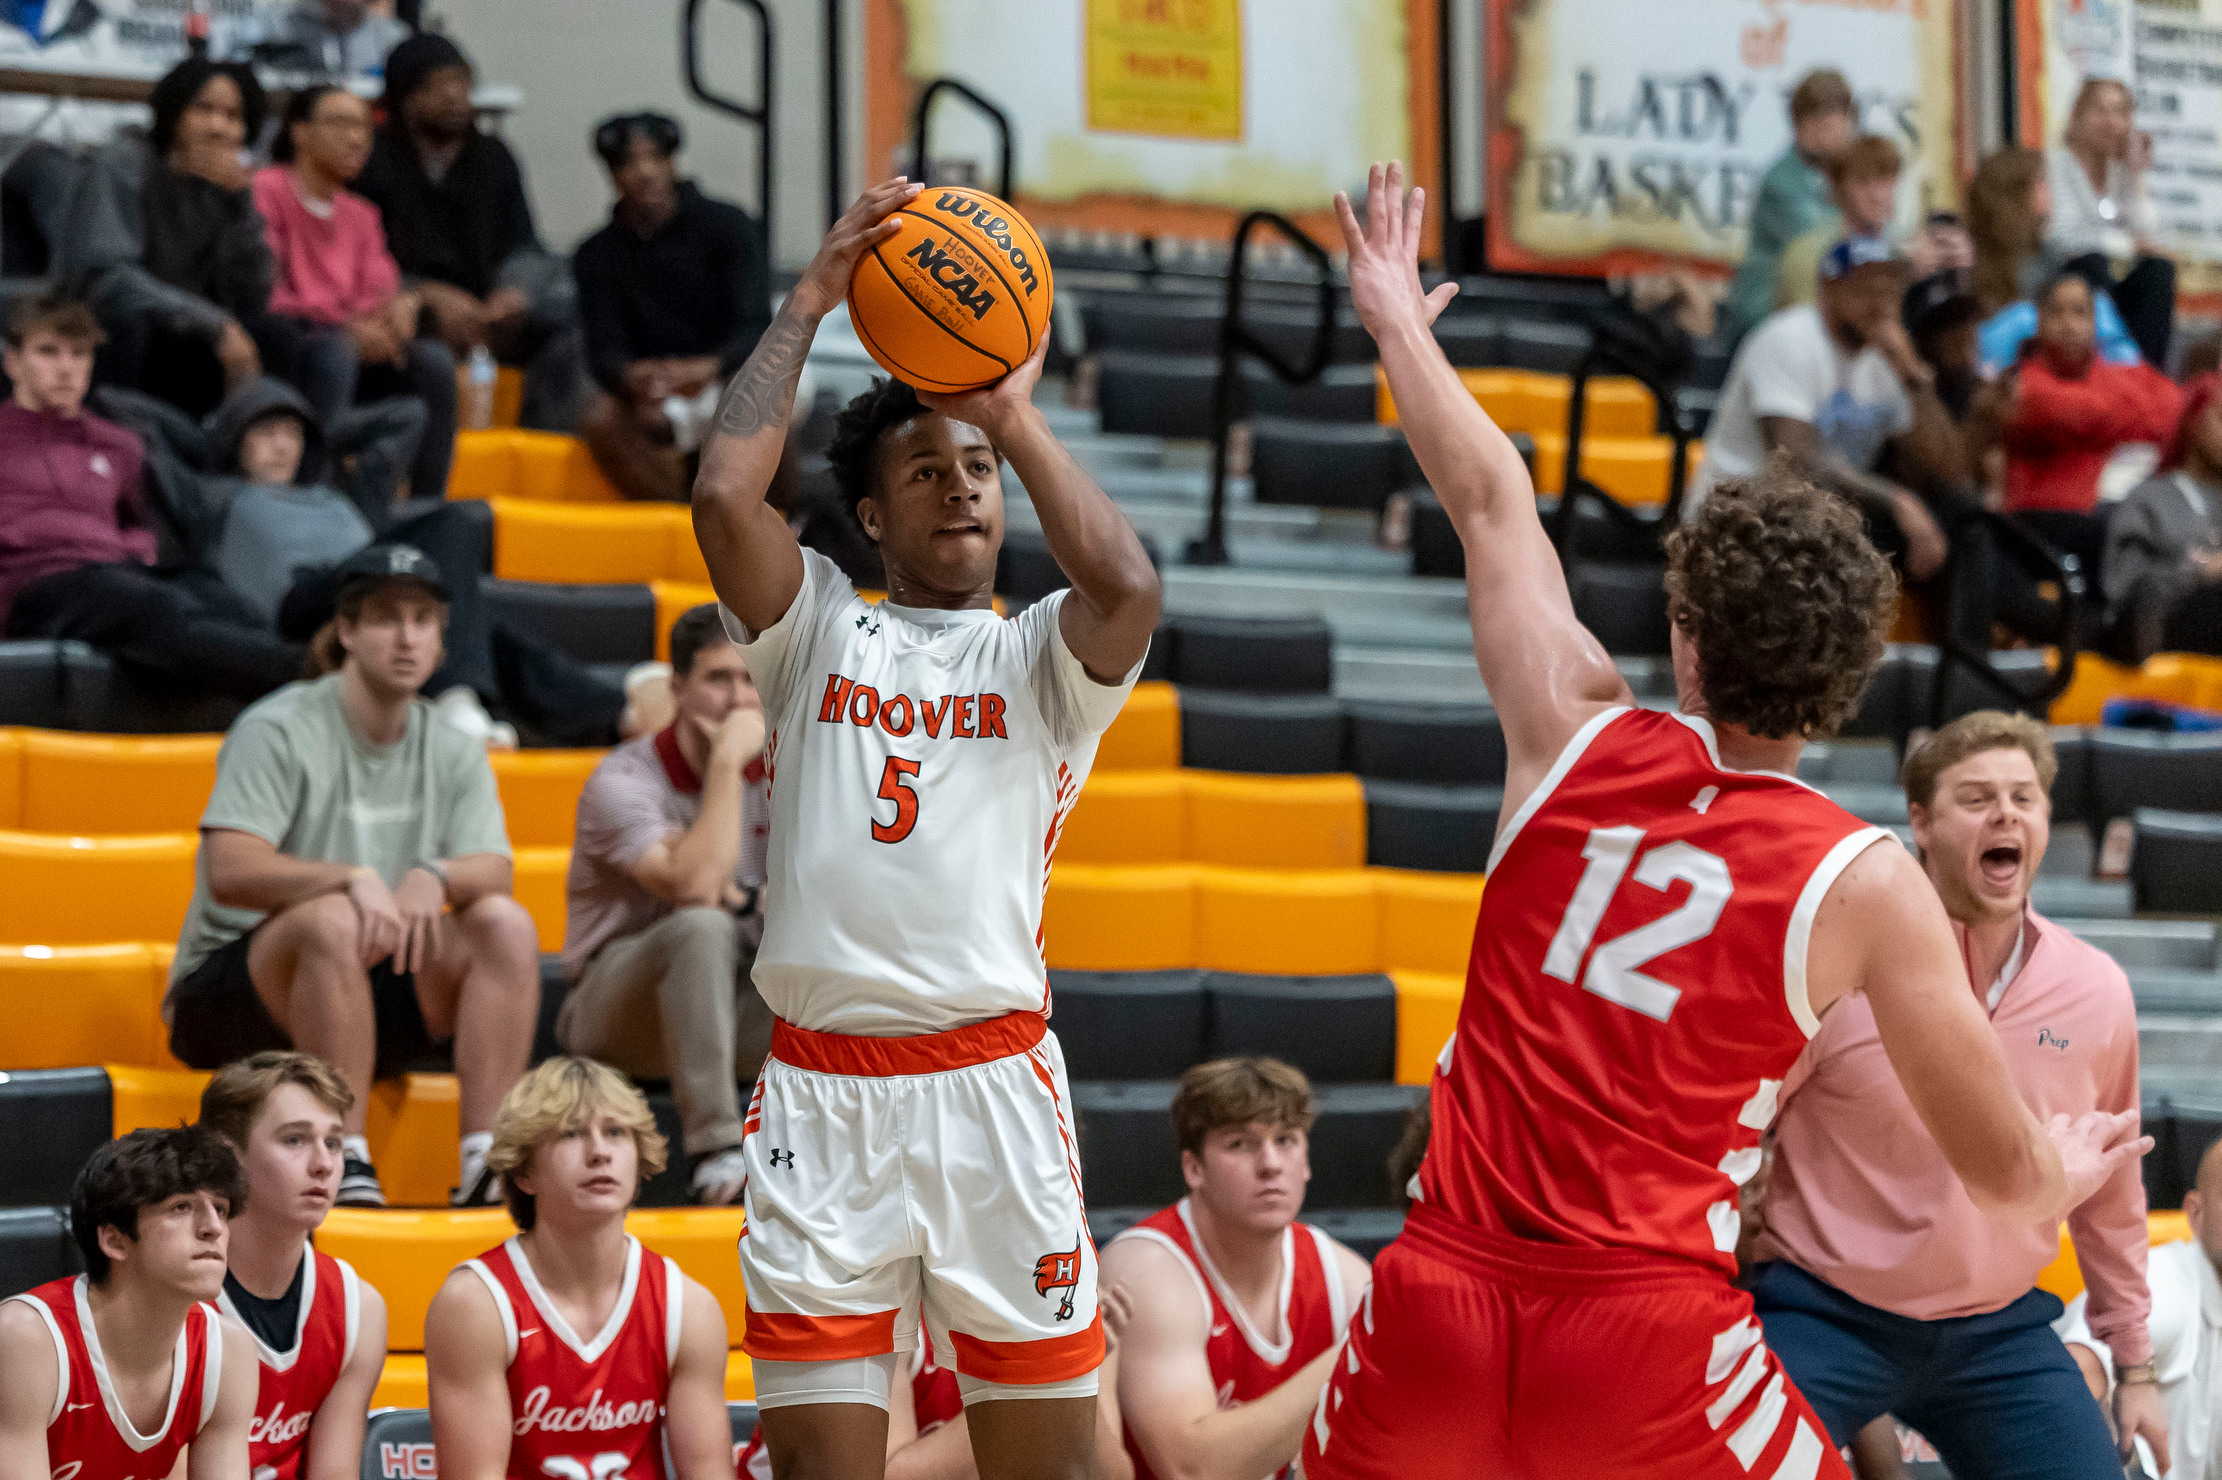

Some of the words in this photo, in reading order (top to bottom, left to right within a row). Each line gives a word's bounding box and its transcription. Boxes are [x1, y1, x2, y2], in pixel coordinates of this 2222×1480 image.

[1577, 68, 1754, 146] LADY
[1537, 146, 1759, 238] BASKE
[905, 237, 998, 322] NCAA
[934, 192, 1039, 298] Wilson
[900, 257, 931, 287] OFFICIAL
[931, 281, 956, 308] GAME
[954, 306, 975, 329] BALL
[816, 673, 1010, 741] HOOVER
[870, 755, 922, 845] 5
[1540, 824, 1735, 1024] 12
[2037, 1027, 2070, 1051] Prep
[1053, 1256, 1076, 1284] H
[514, 1385, 656, 1437] Jackson
